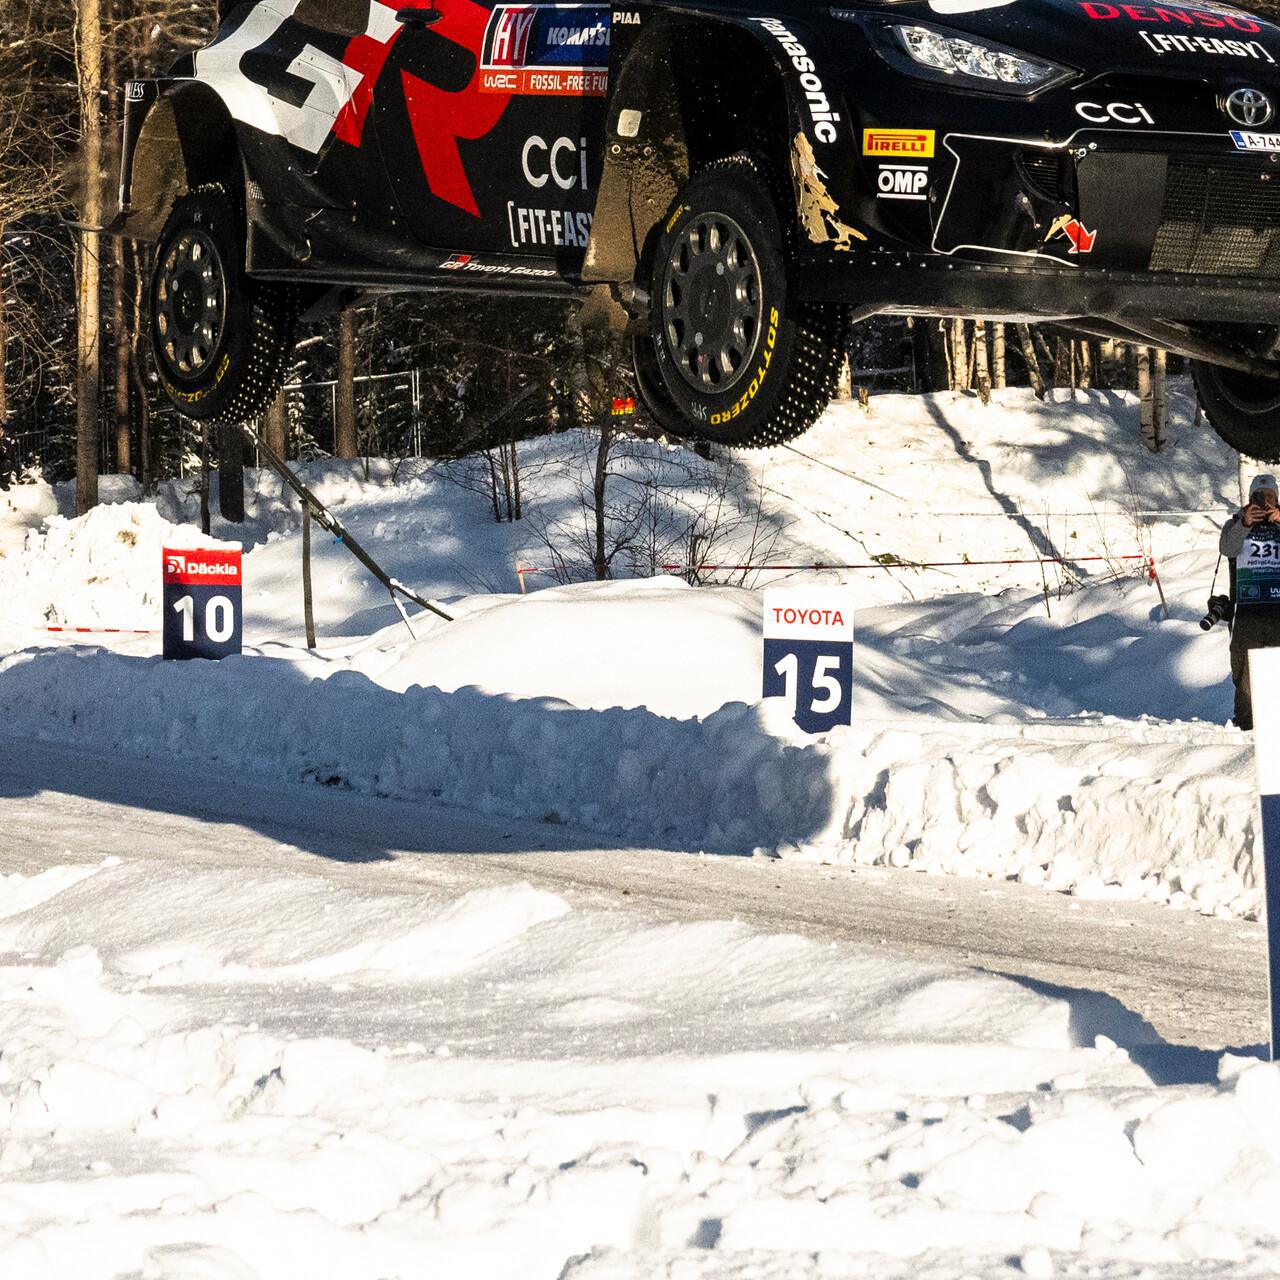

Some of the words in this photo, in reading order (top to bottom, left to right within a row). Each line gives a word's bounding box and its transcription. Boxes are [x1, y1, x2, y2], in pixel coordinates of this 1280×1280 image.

[613, 12, 641, 24] PIAA
[1078, 2, 1262, 33] DENSO
[484, 75, 517, 89] WRC
[530, 75, 590, 91] FOSSIL-FREE
[868, 134, 927, 151] PIRELLI
[878, 171, 928, 193] OMP
[711, 306, 779, 425] SOTTOZERO
[1250, 543, 1280, 560] 231
[187, 562, 237, 575] Däckia
[173, 595, 234, 642] 10
[773, 608, 844, 626] TOYOTA
[774, 653, 842, 714] 15
